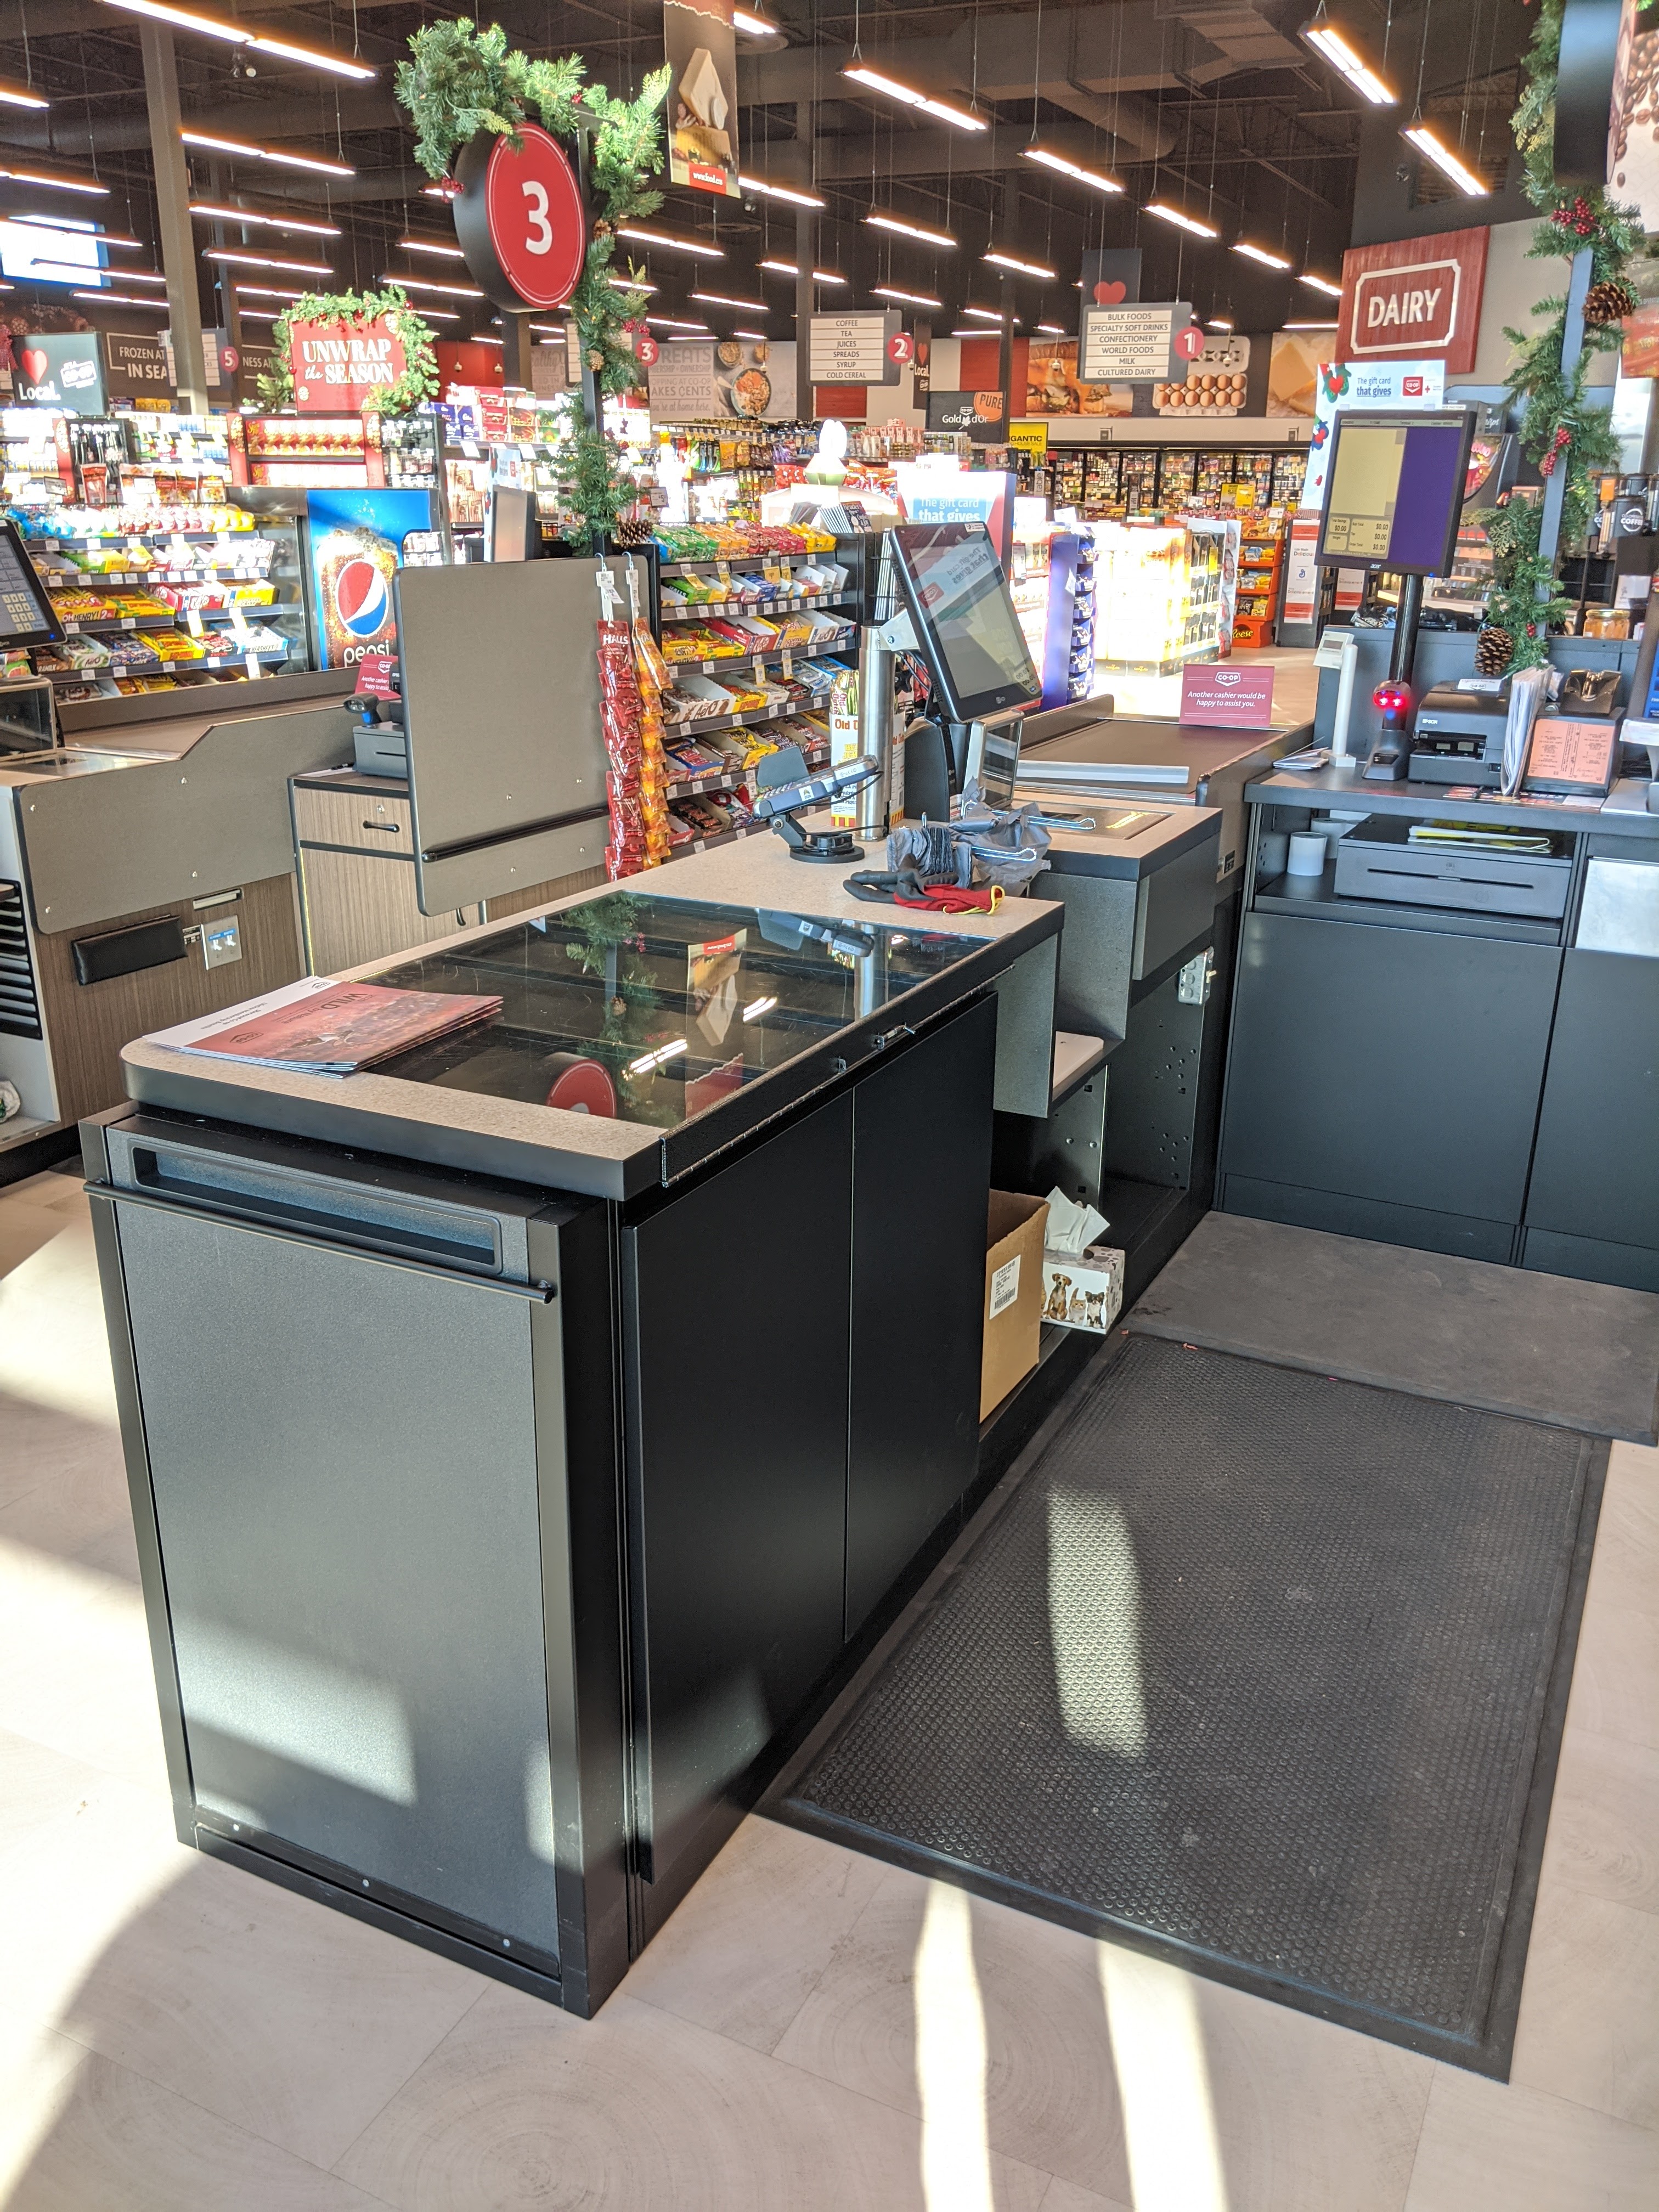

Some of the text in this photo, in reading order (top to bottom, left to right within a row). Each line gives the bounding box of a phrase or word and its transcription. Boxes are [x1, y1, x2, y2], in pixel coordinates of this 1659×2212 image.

[522, 180, 553, 255] 3
[1367, 288, 1442, 328] DAIRY
[1099, 335, 1158, 343] CONFECTIONERY
[1184, 332, 1195, 354] 1
[119, 346, 154, 359] FROZEN
[302, 338, 391, 363] UNWRAP
[641, 343, 653, 360] 3
[894, 338, 908, 358] 2
[224, 351, 234, 366] 5
[659, 347, 712, 363] REATS
[242, 357, 262, 368] NESS
[680, 364, 712, 373] OWNERSHIP
[127, 363, 143, 378] IN
[305, 363, 393, 384] the SEASON
[1368, 376, 1378, 386] gift
[651, 386, 676, 396] AKES
[1357, 385, 1392, 397] that gives
[979, 393, 1003, 410] PURE
[942, 414, 989, 424] Gold d'Or
[921, 498, 979, 510] The gift card
[918, 508, 981, 522] that gives
[74, 611, 99, 622] HENRY!
[603, 634, 629, 645] HALLS
[1196, 699, 1216, 708] happy
[834, 719, 850, 730] Old
[320, 993, 368, 1009] WILD
[235, 1032, 259, 1043] CO-OP
